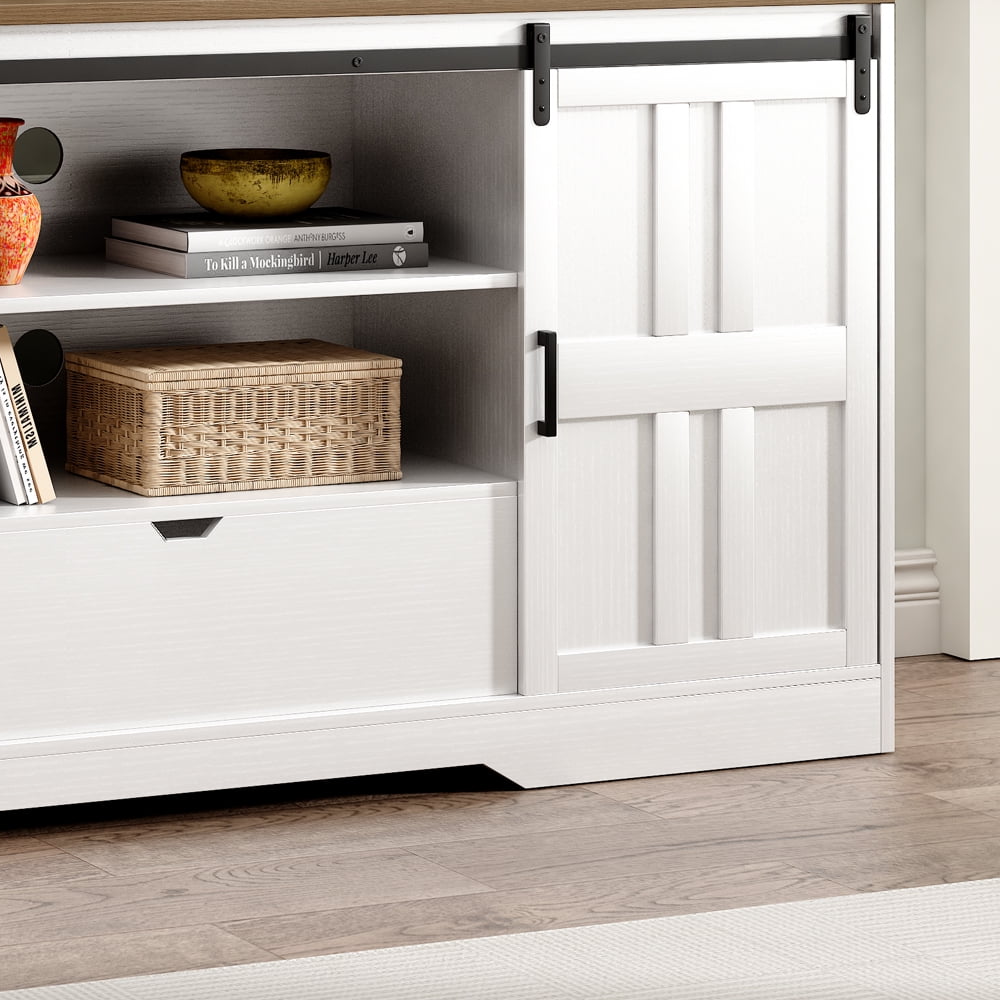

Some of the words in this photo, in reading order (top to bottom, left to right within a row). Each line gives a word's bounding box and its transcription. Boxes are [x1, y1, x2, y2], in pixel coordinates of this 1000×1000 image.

[204, 258, 219, 271] To
[220, 256, 240, 271] Kill
[241, 260, 247, 270] a
[249, 252, 315, 270] Mockingbird
[327, 252, 361, 268] Harper
[362, 251, 378, 265] Lee
